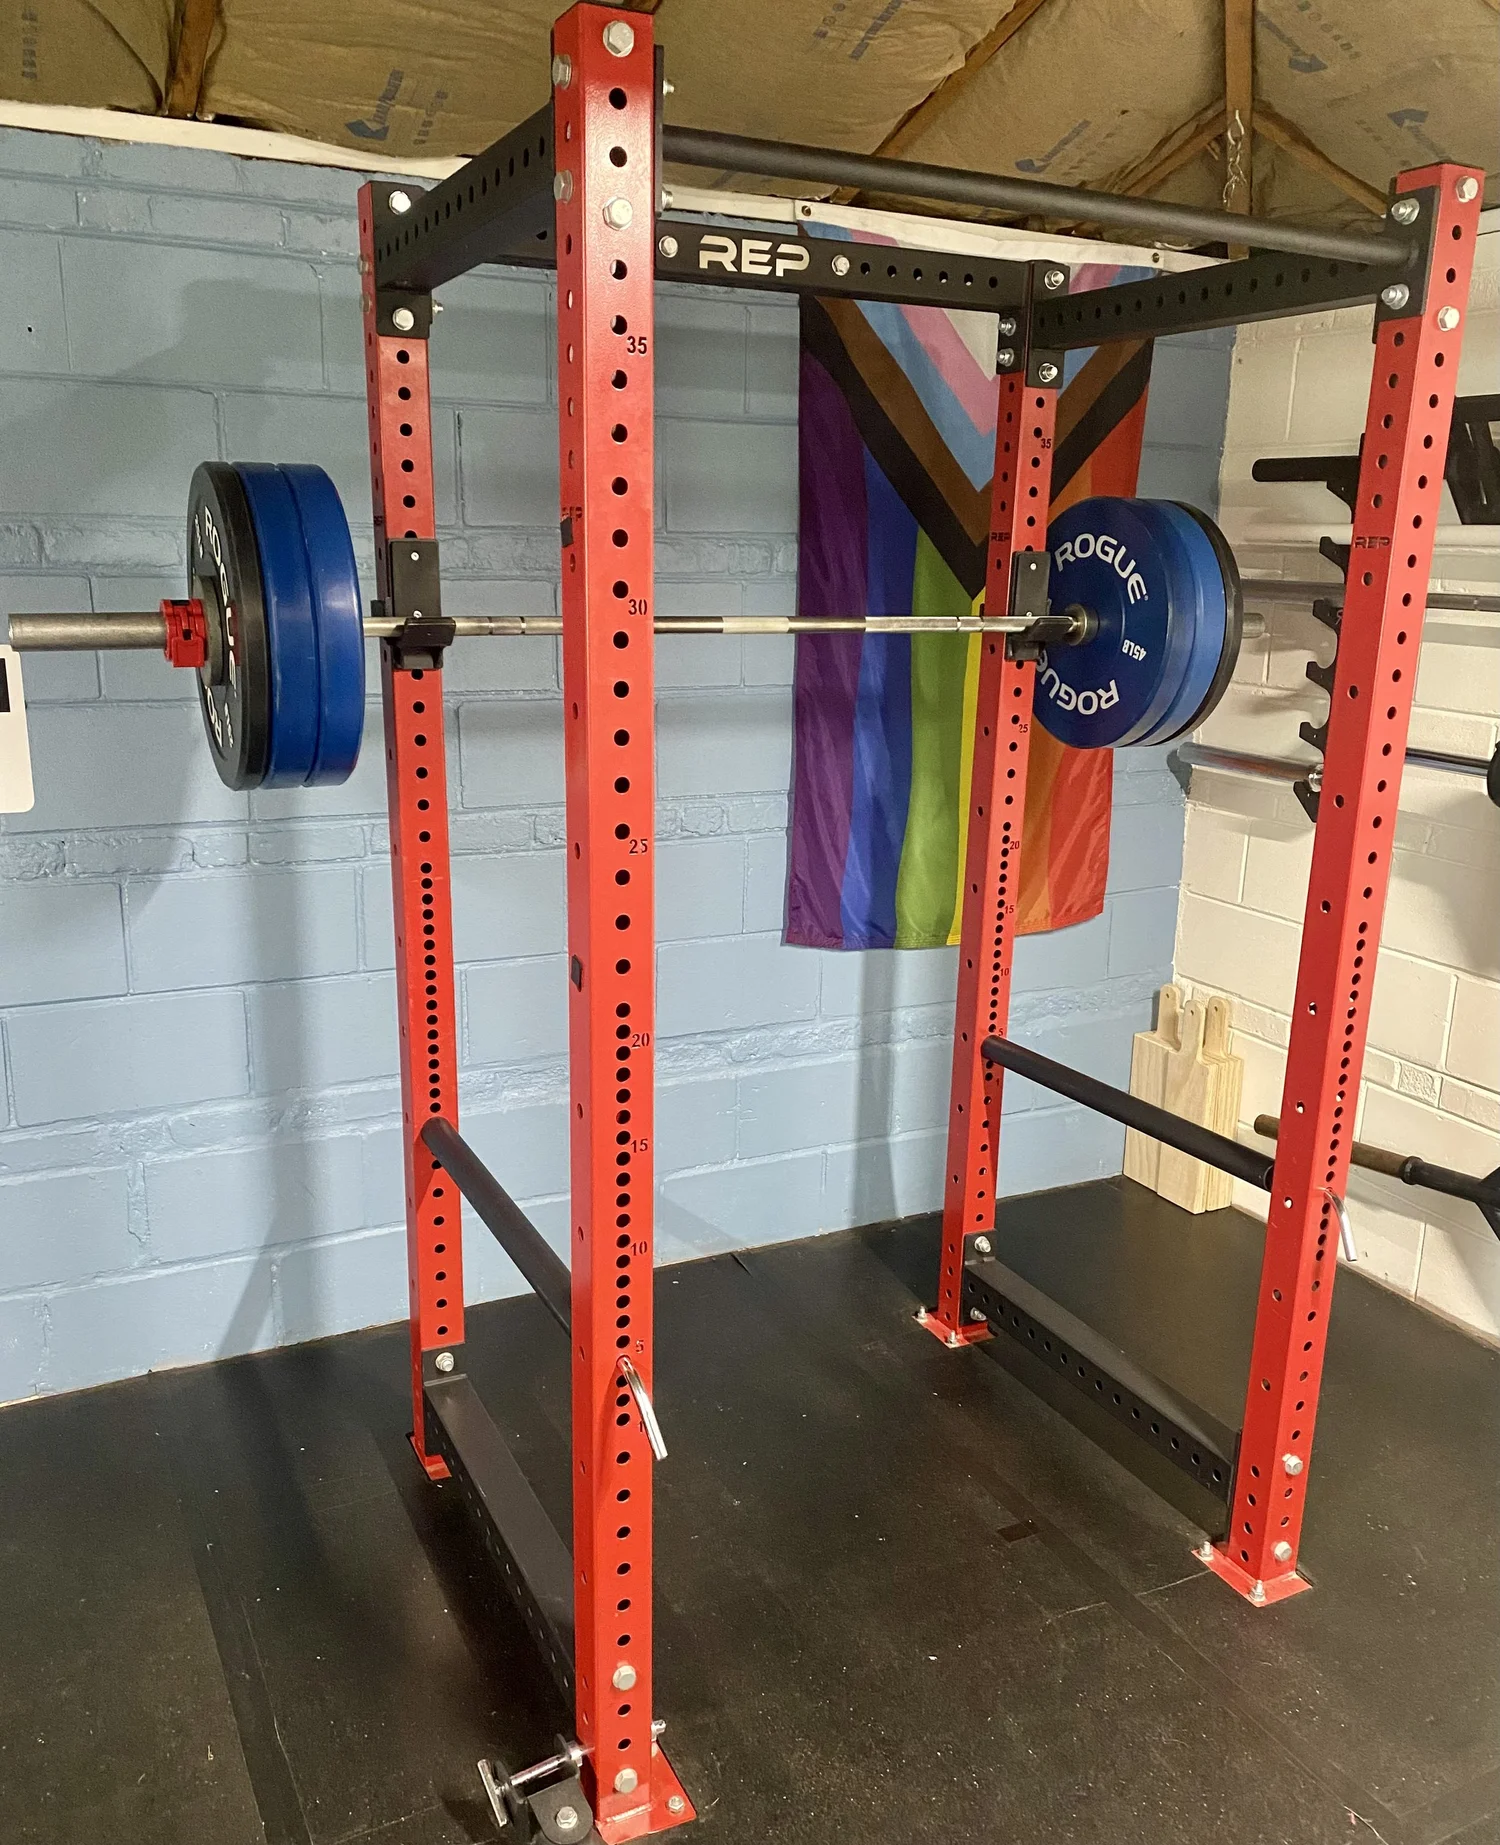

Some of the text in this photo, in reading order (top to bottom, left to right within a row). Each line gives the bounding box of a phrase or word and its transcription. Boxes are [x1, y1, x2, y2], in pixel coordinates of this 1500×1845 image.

[699, 234, 810, 277] REP
[627, 336, 647, 355] 35
[1041, 438, 1052, 449] 35
[1355, 536, 1391, 549] REP
[1054, 533, 1147, 604] ROGUE
[204, 505, 237, 686] ROGUE
[628, 598, 648, 616] 30
[1122, 639, 1147, 661] 45LB
[1019, 723, 1029, 734] 25
[629, 838, 648, 854] 25
[1010, 840, 1020, 850] 20
[1005, 904, 1015, 914] 15
[1000, 967, 1010, 977] 10
[631, 1032, 650, 1048] 20
[998, 1028, 1004, 1037] 5
[630, 1138, 648, 1154] 15
[630, 1240, 648, 1256] 10
[635, 1339, 644, 1353] 5
